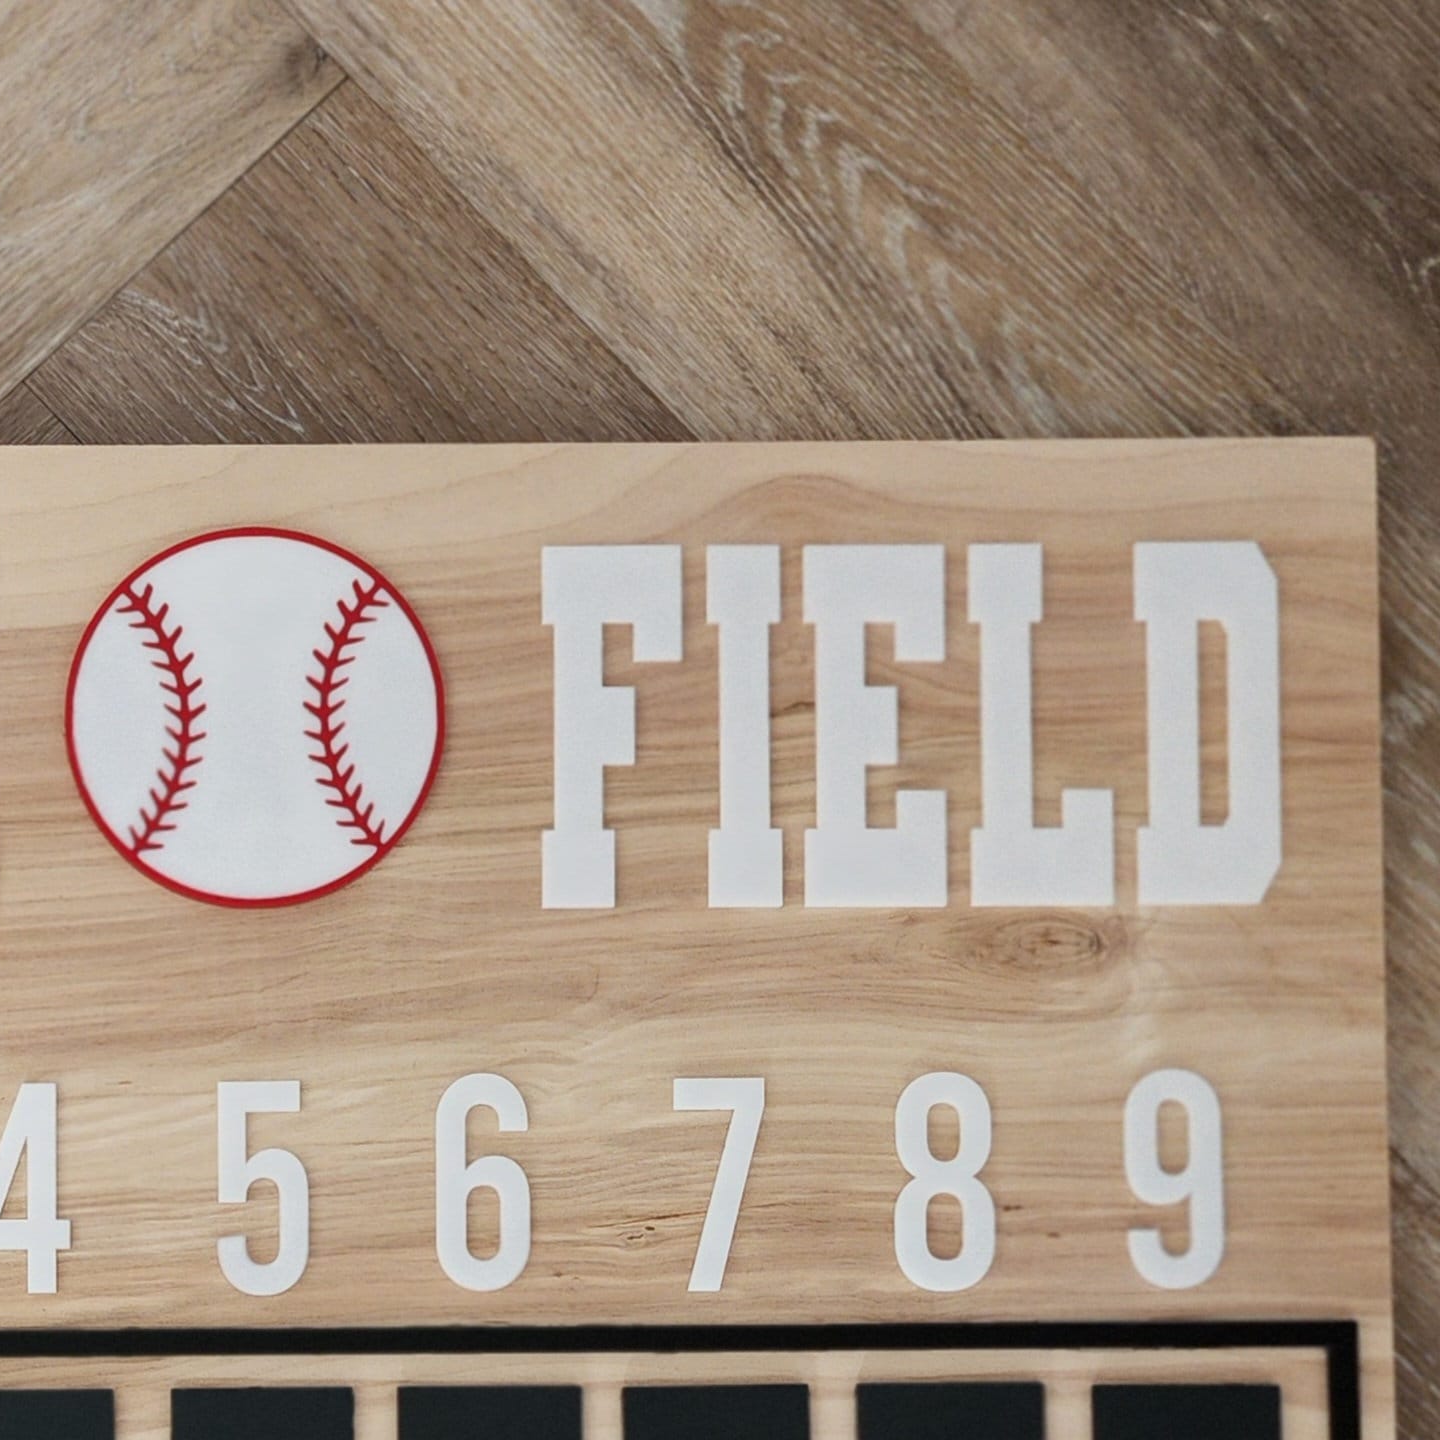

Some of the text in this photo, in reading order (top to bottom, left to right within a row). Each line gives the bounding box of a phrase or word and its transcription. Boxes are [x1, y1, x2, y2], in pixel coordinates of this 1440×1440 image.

[541, 540, 1282, 909] FIELD
[217, 1078, 309, 1296] 5
[435, 1073, 531, 1291] 6
[673, 1077, 765, 1293] 7
[895, 1072, 996, 1292] 8
[1124, 1068, 1226, 1289] 9
